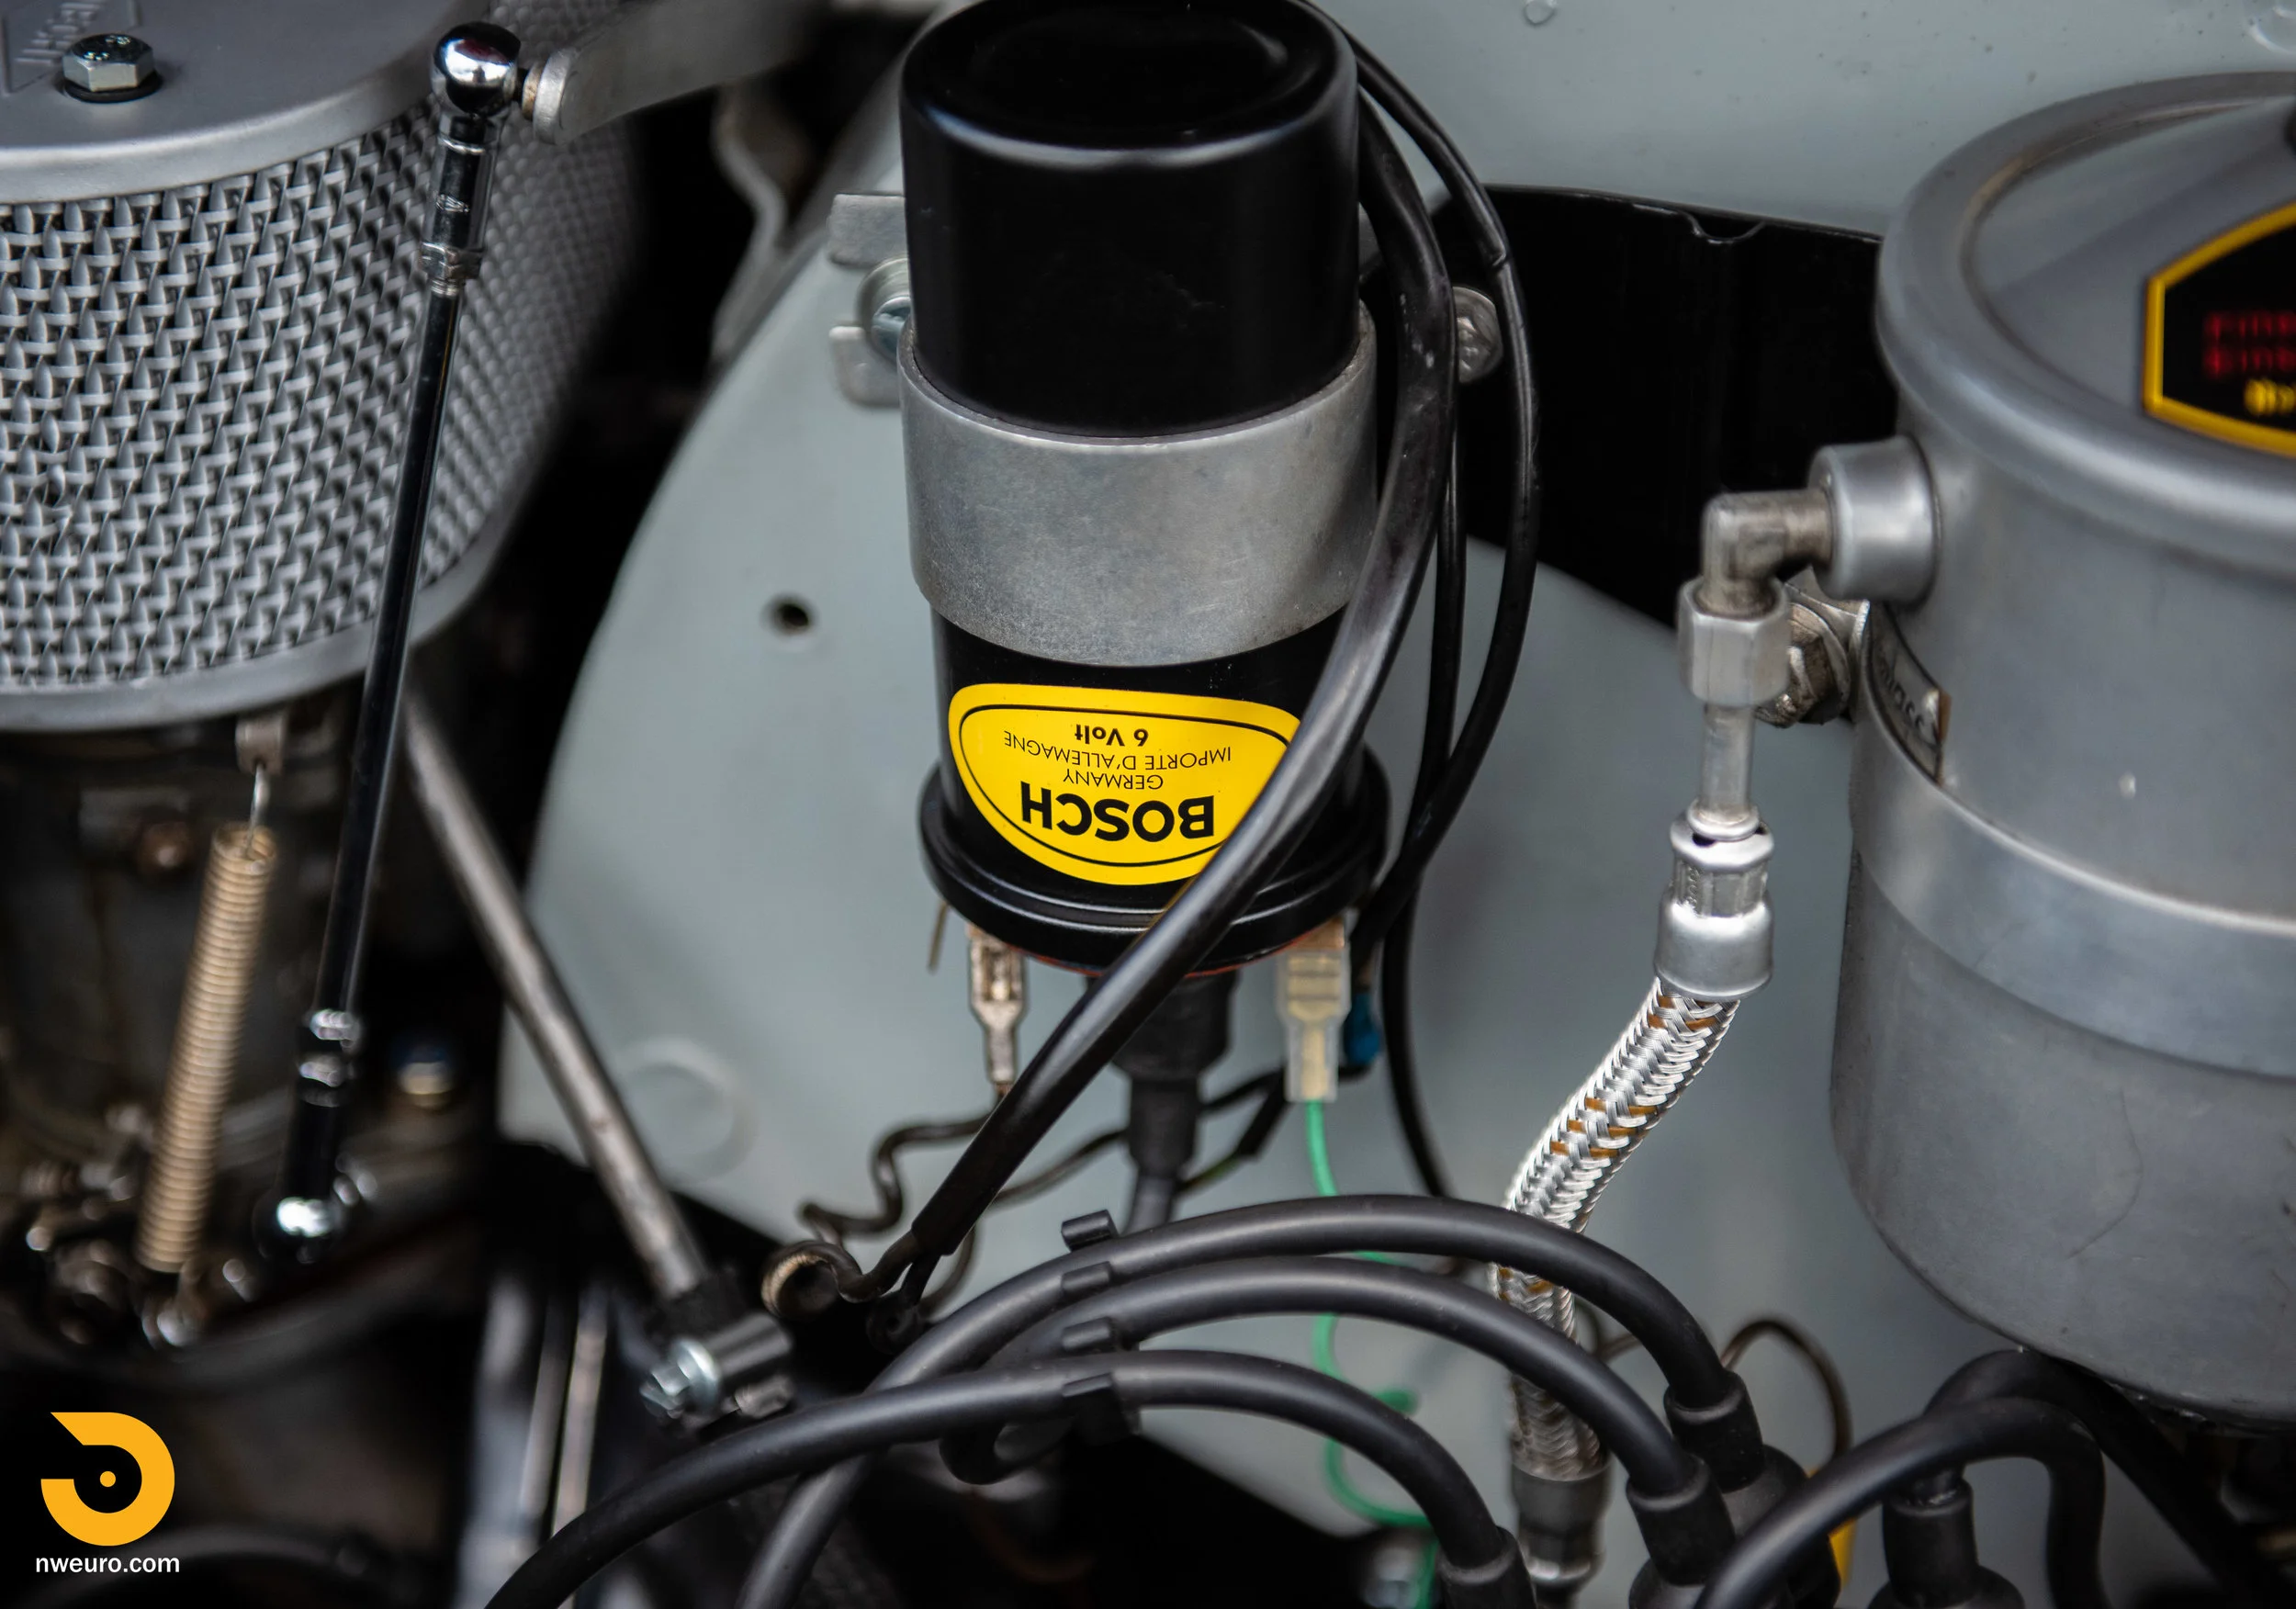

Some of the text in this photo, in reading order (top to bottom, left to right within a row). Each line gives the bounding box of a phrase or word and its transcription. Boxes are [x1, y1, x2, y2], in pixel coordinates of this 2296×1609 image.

[1004, 731, 1232, 771] IMPORTE D'ALLEMAGNE
[1075, 724, 1149, 747] 6 Volt
[1064, 769, 1164, 790] GERMANY
[1020, 781, 1215, 842] BOSCH
